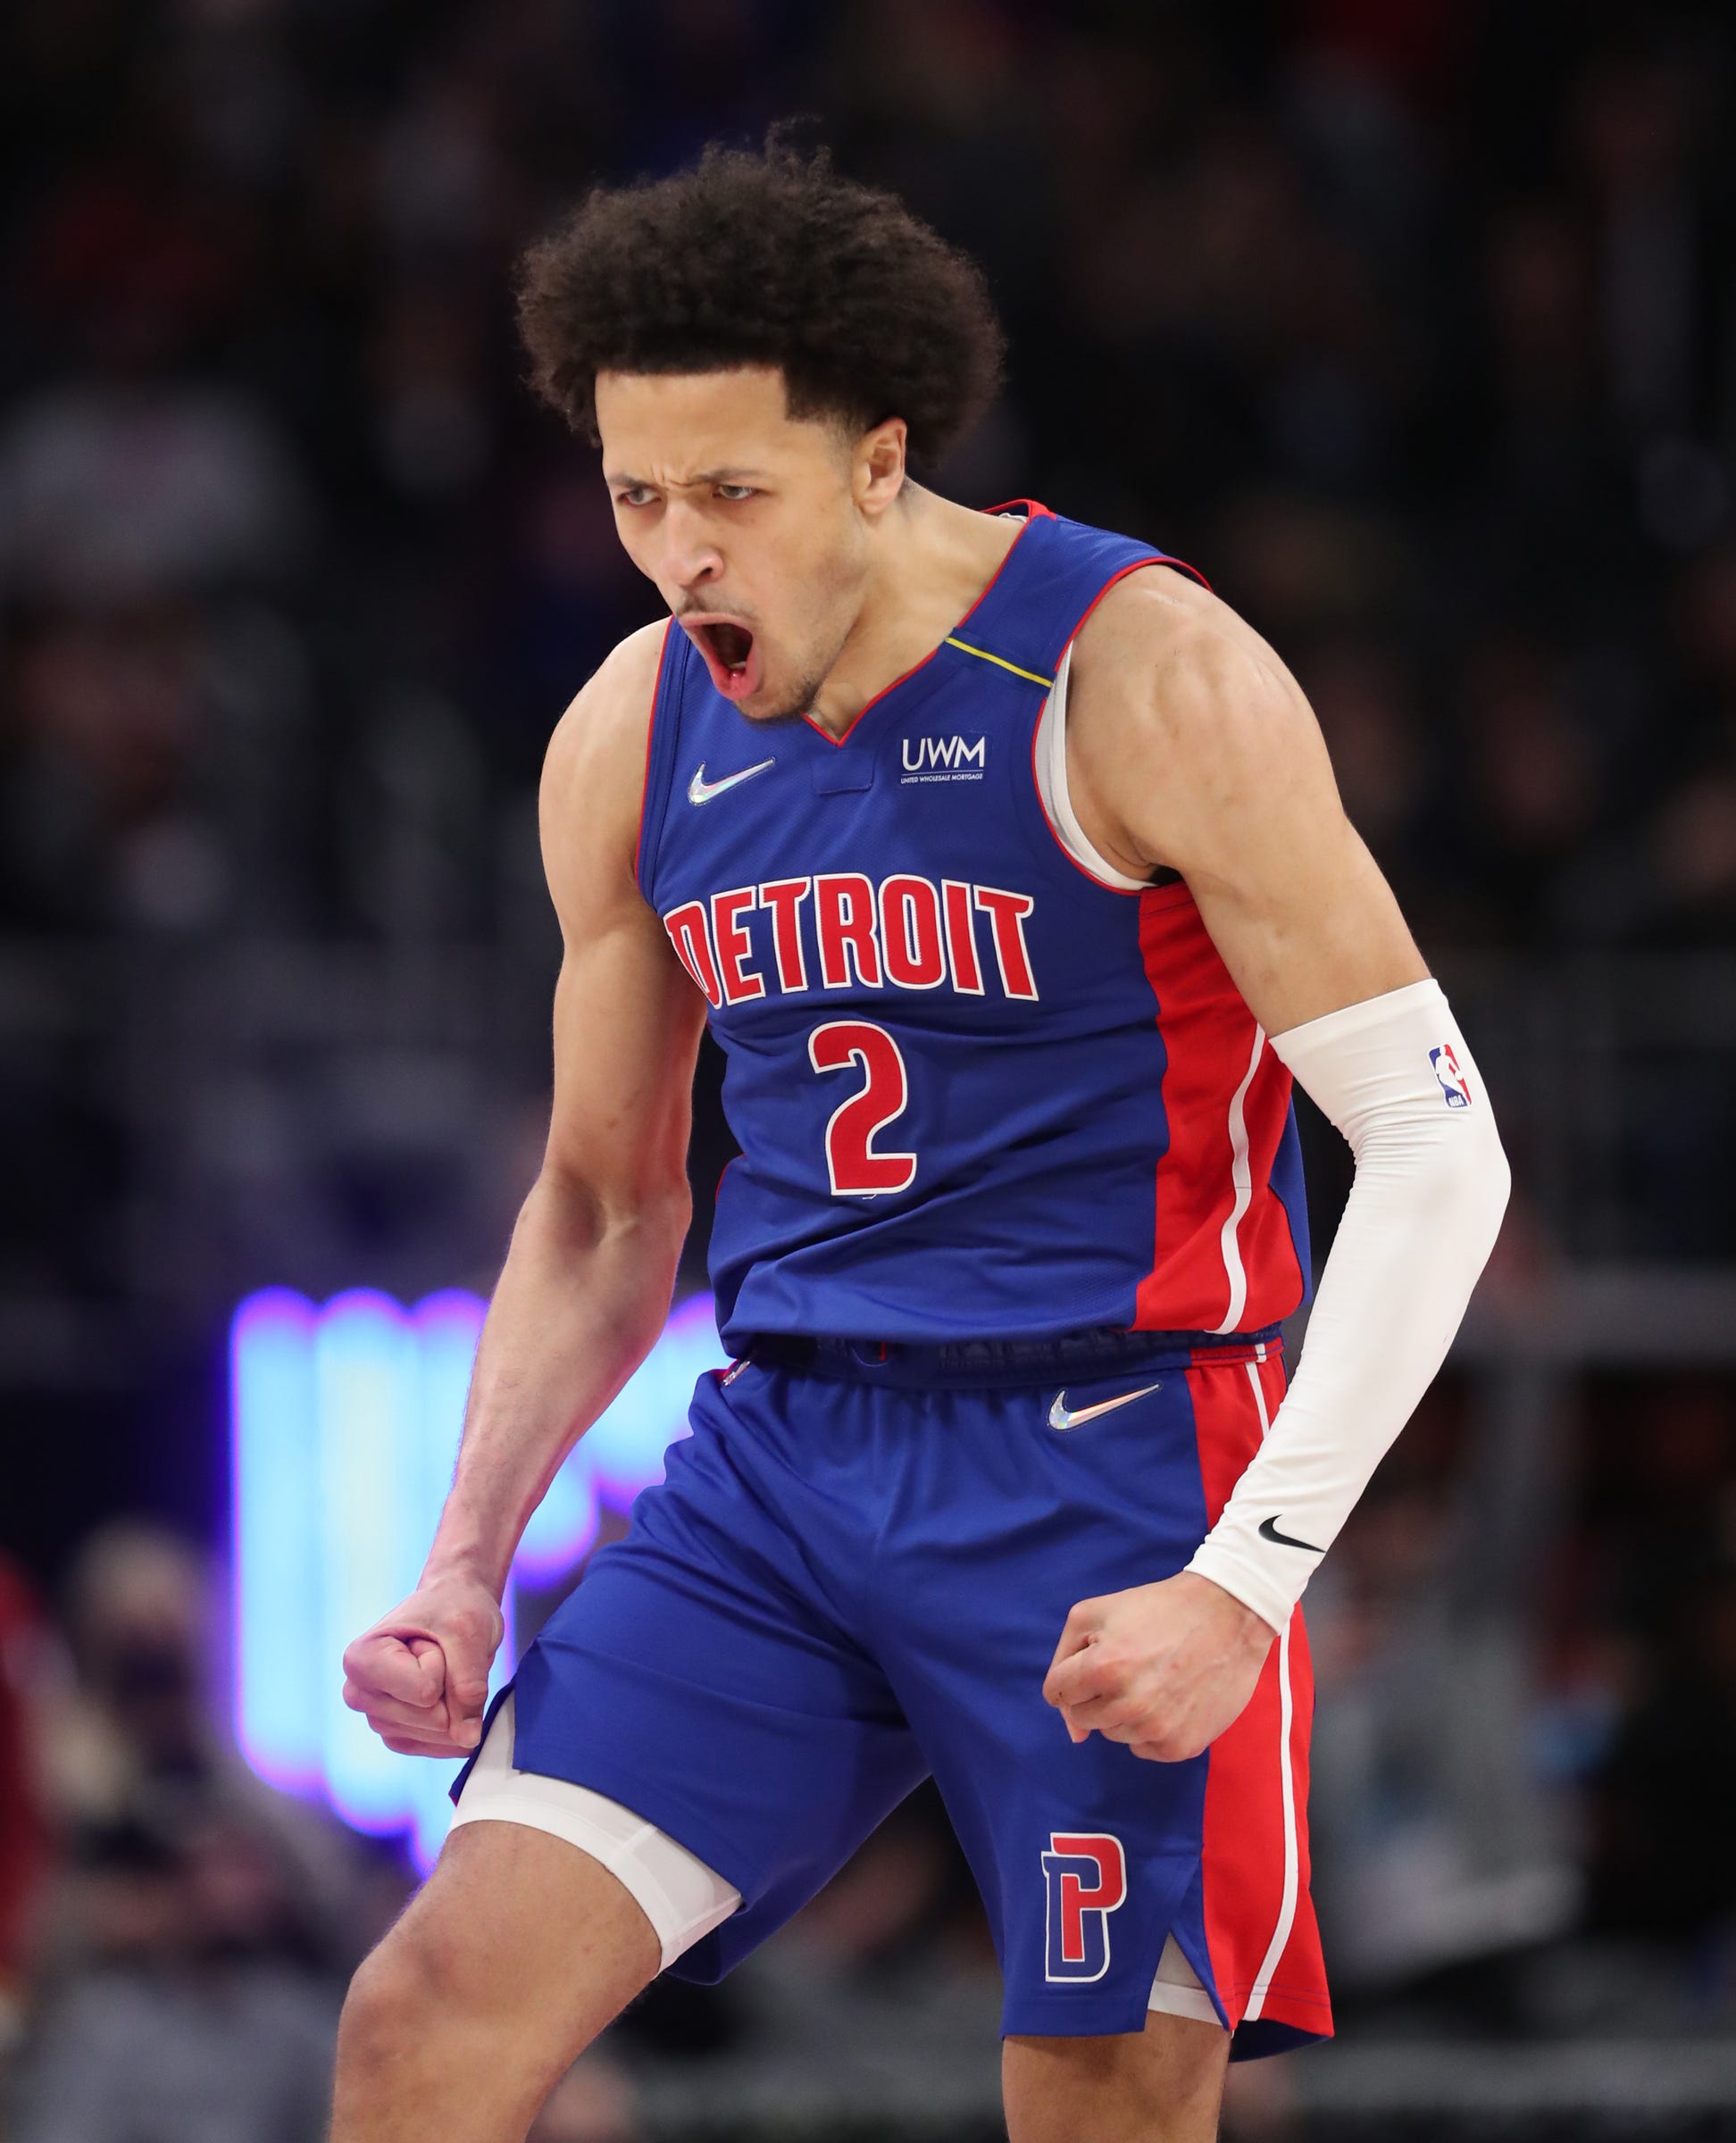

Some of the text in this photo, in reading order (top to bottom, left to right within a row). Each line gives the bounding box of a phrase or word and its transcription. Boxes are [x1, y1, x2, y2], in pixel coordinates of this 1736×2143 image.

[902, 735, 985, 771] UWM
[900, 773, 983, 784] UNITED WHOLESALE MORTGAGE
[663, 872, 1039, 1010] DETROIT
[807, 1021, 917, 1196] 2
[1448, 1095, 1464, 1106] NBA
